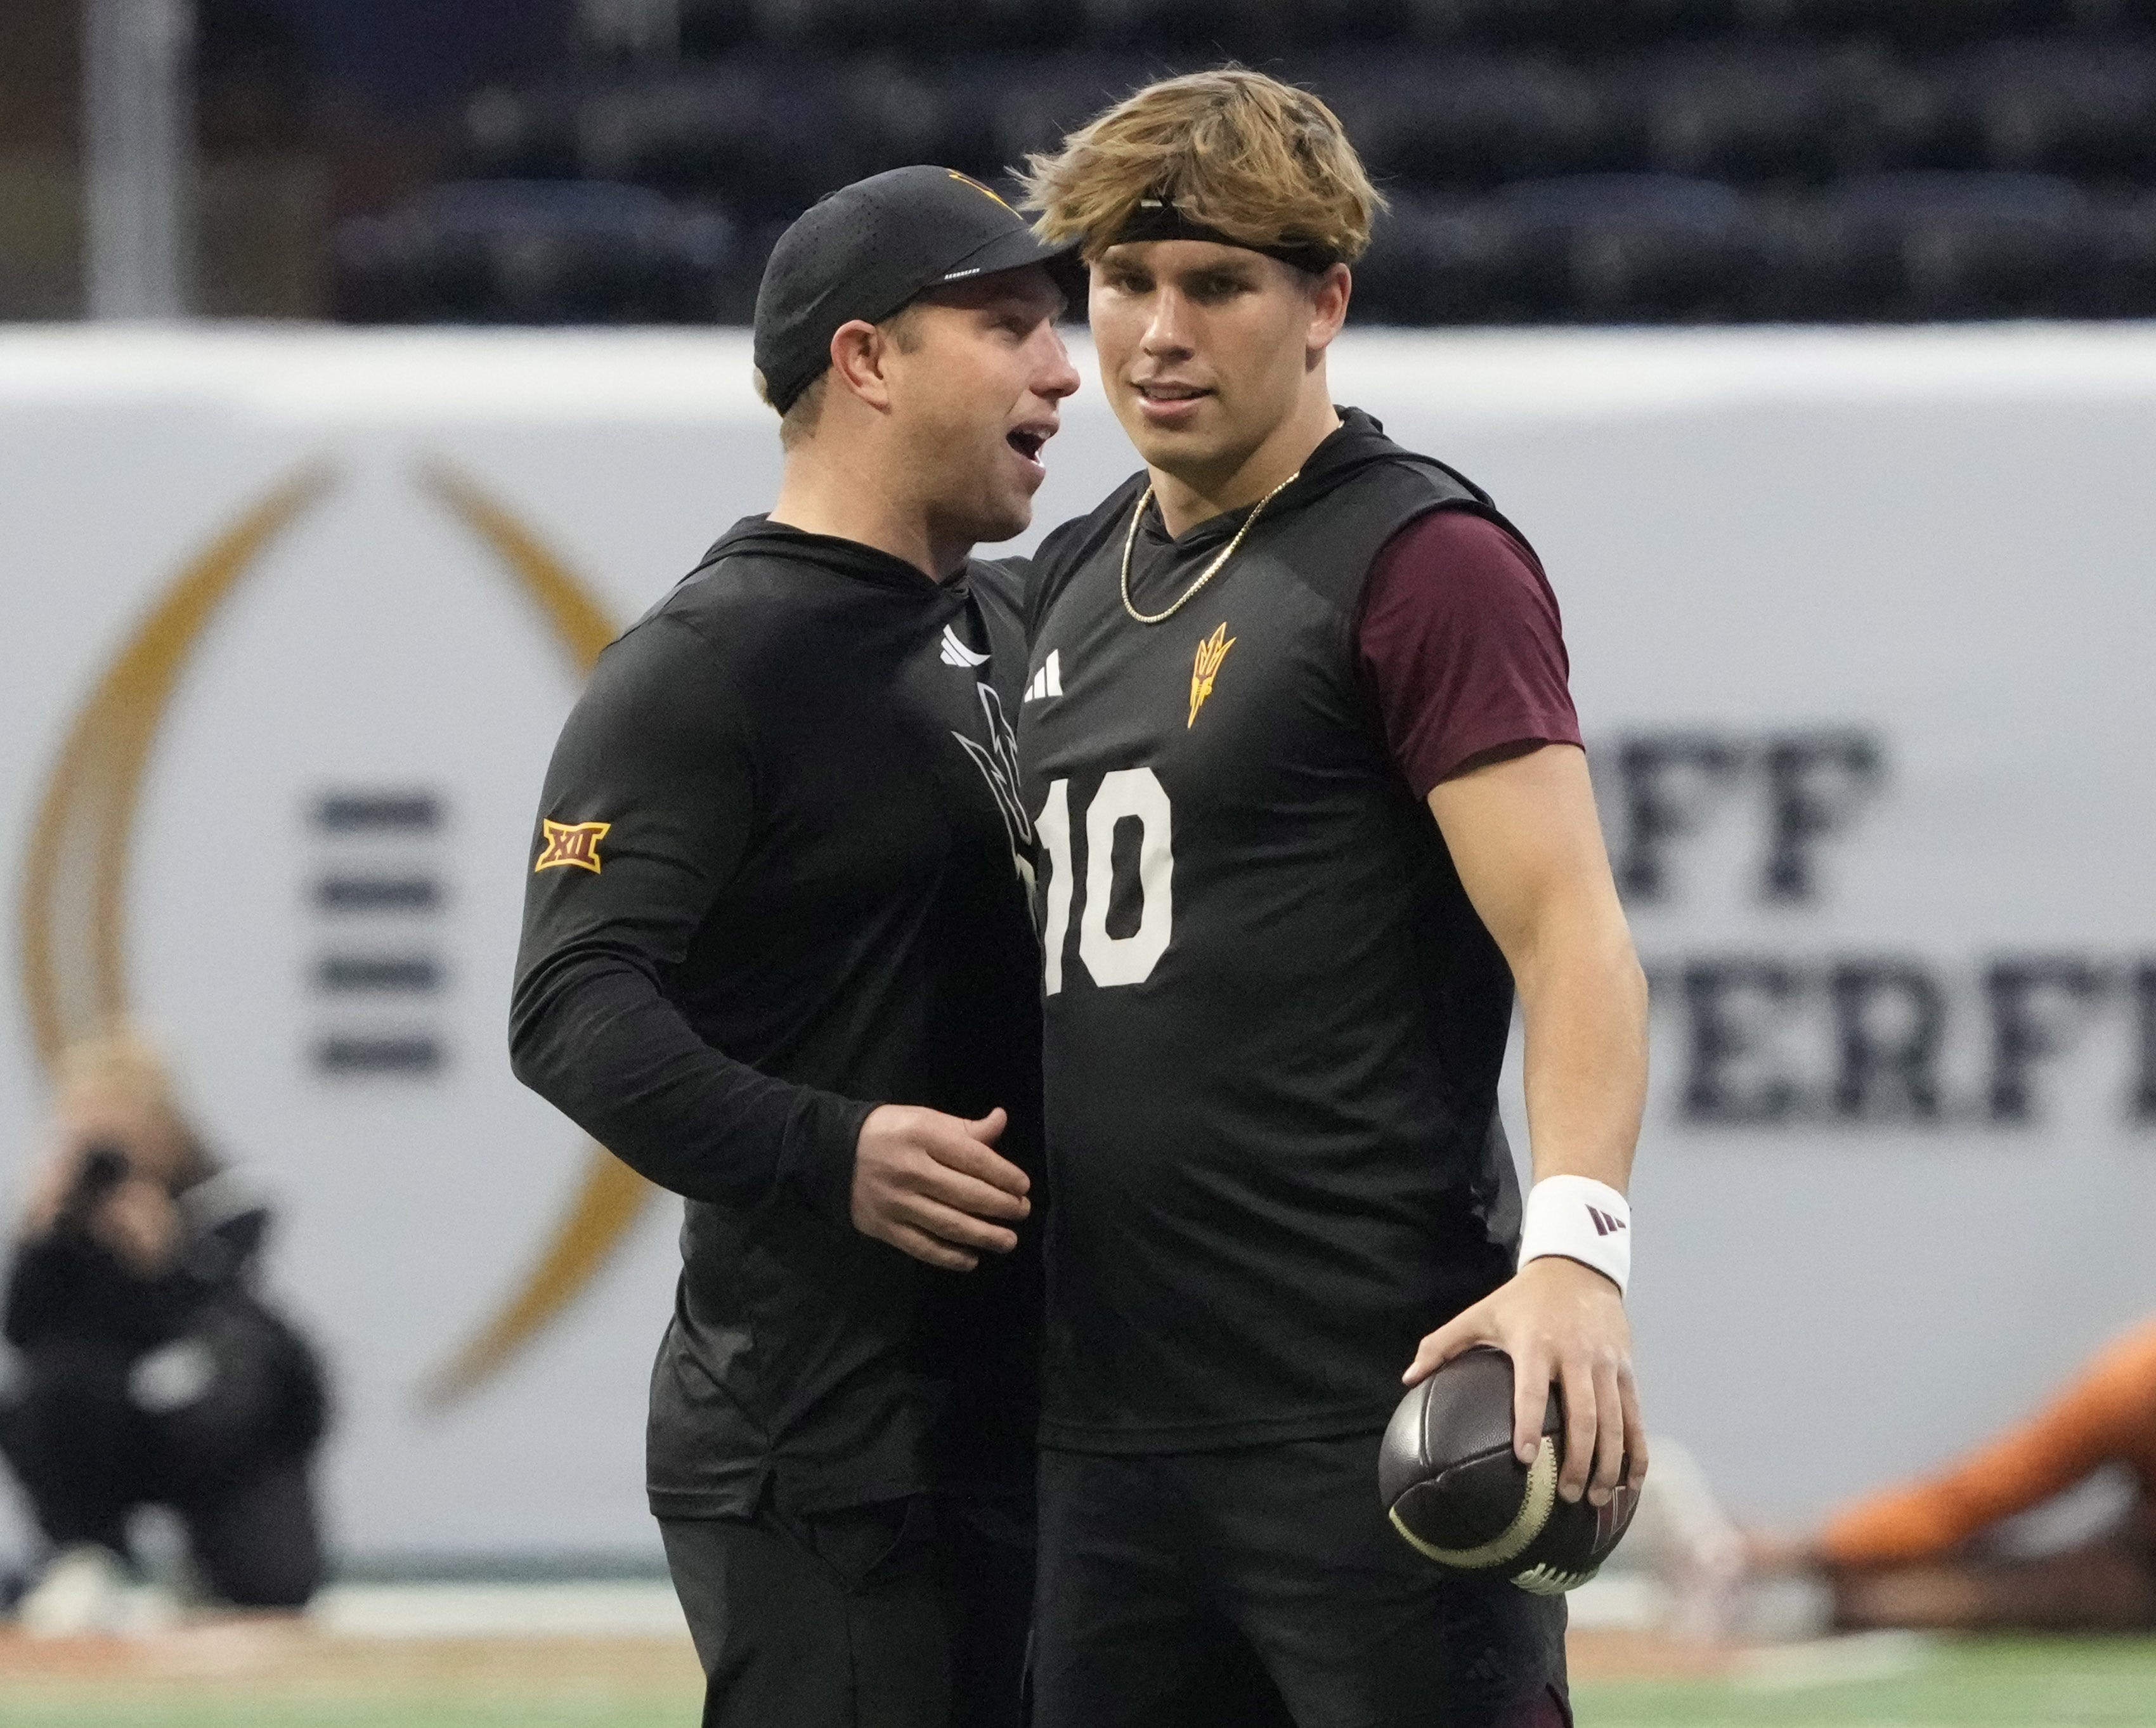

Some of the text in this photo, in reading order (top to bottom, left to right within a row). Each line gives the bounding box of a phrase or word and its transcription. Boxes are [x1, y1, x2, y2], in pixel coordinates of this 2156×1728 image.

[541, 826, 603, 866] XII
[1034, 767, 1173, 996] 10
[1585, 727, 1886, 907] FF
[1647, 956, 2156, 1129] ERF
